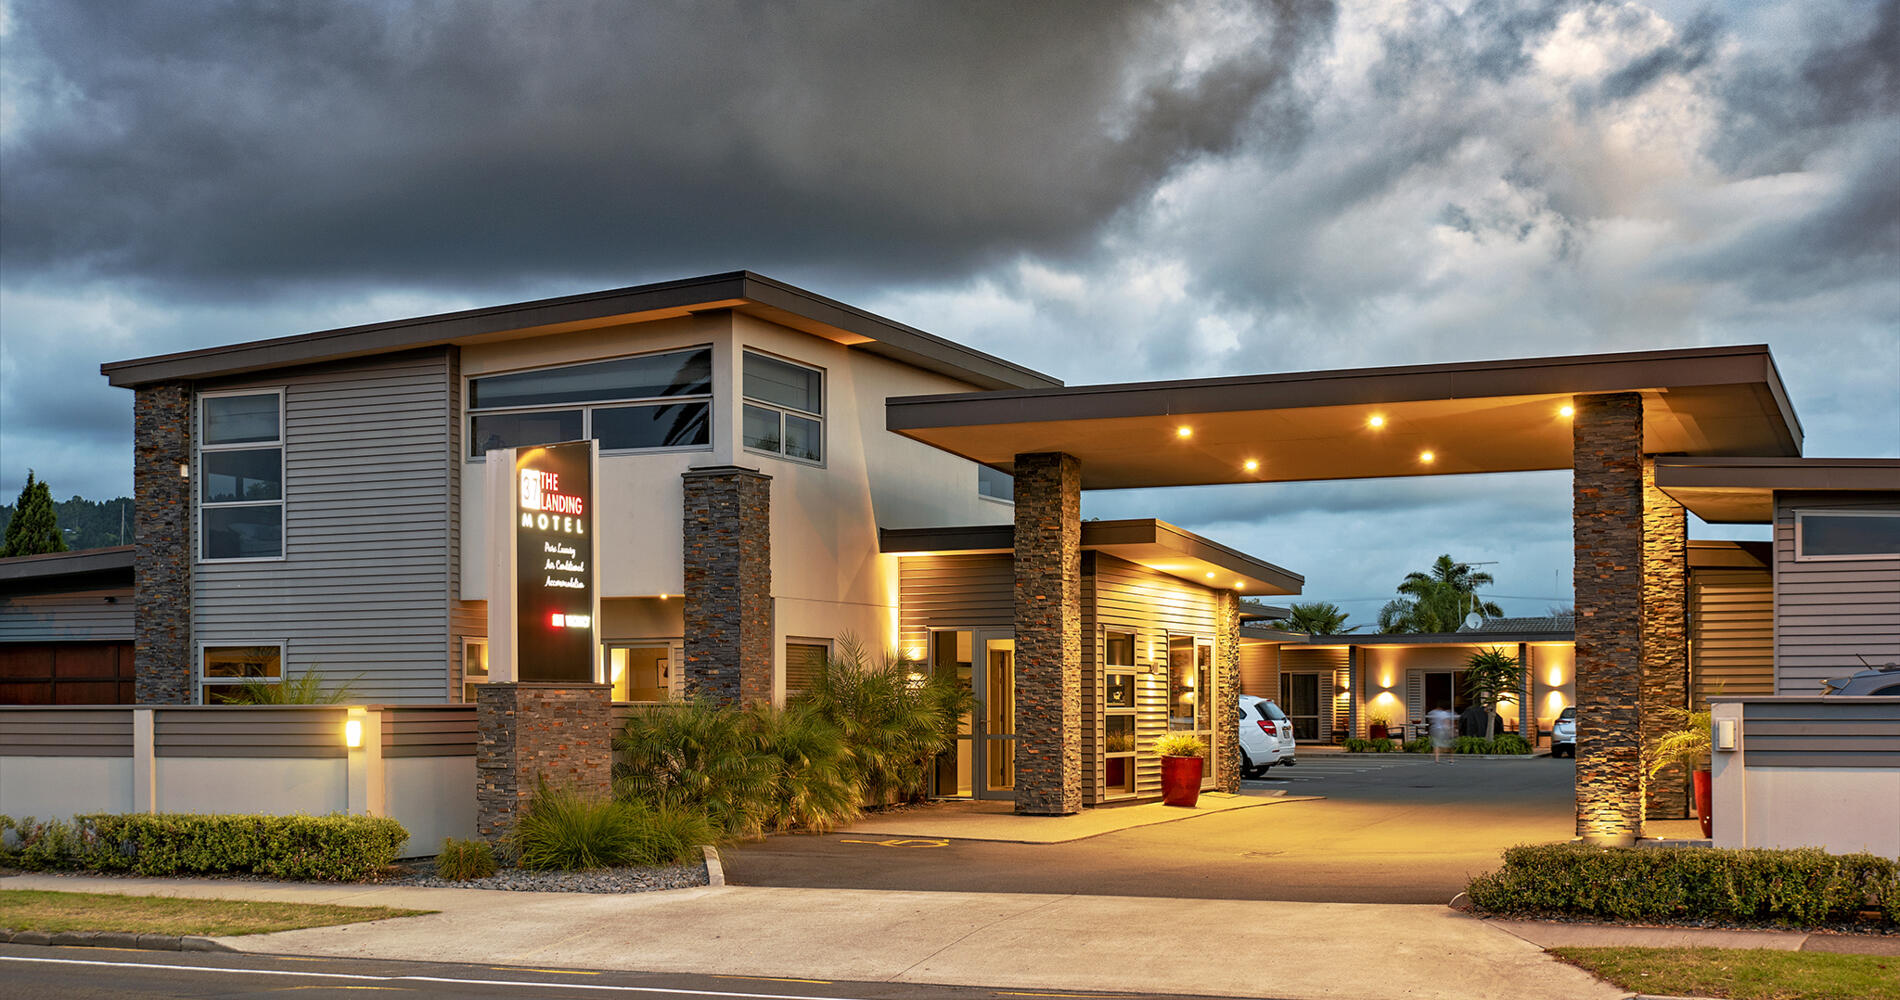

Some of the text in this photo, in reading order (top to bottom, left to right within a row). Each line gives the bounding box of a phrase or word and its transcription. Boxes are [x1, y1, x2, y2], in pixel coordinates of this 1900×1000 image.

[540, 471, 559, 491] THE
[540, 492, 583, 515] LANDING
[521, 512, 584, 534] MOTEL
